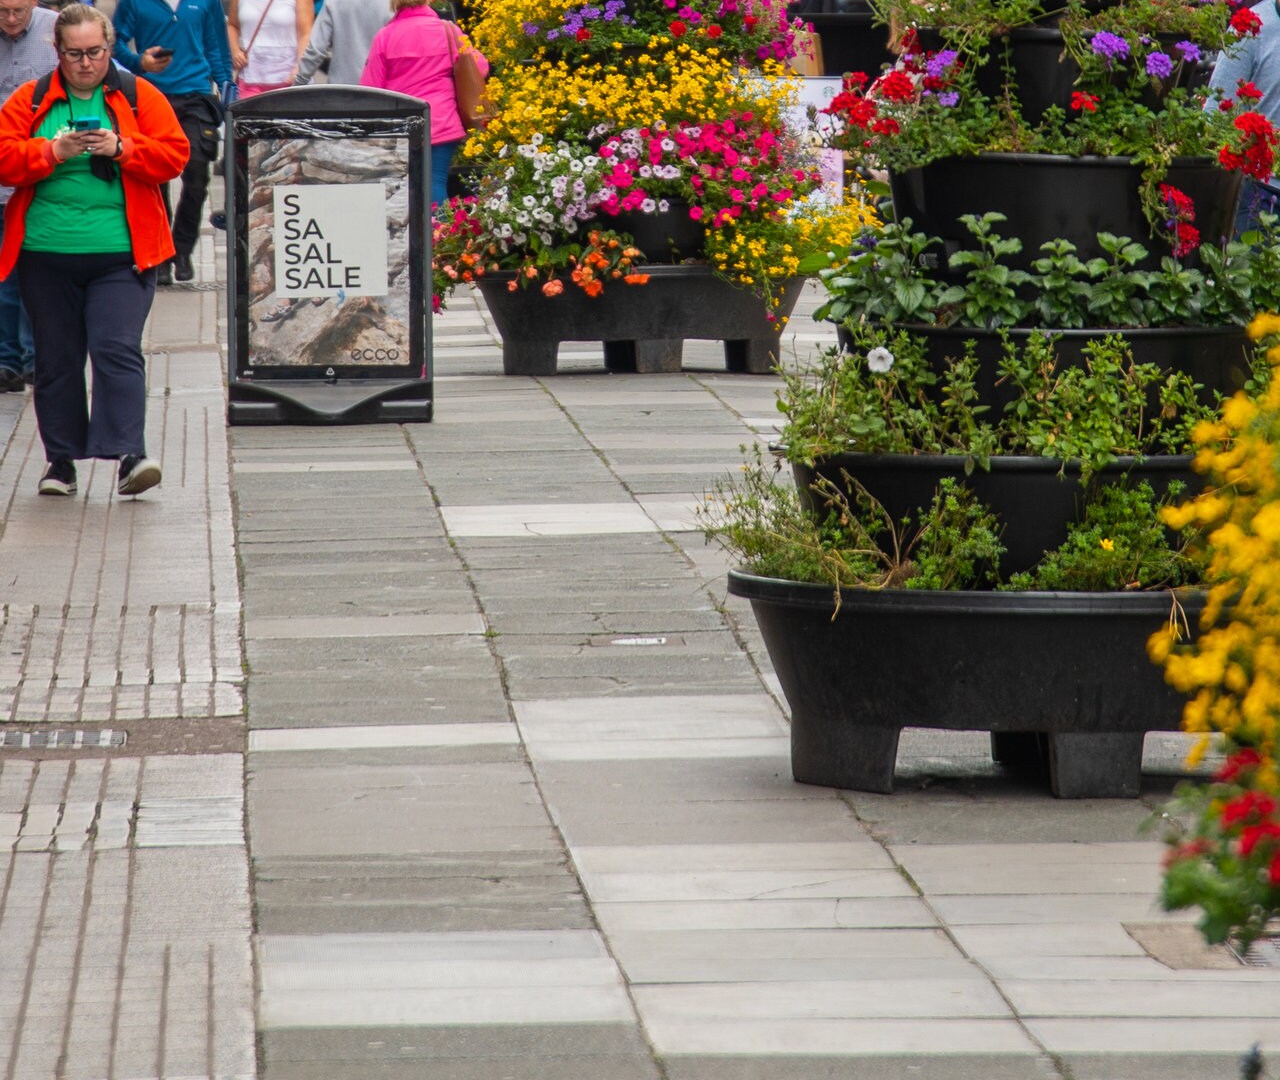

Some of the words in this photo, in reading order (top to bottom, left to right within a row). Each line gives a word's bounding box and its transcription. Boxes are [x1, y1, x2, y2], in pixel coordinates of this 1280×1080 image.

[283, 193, 300, 216] S
[284, 218, 324, 240] SA
[284, 242, 342, 265] SAL
[285, 266, 361, 289] SALE
[351, 348, 400, 361] ecco
